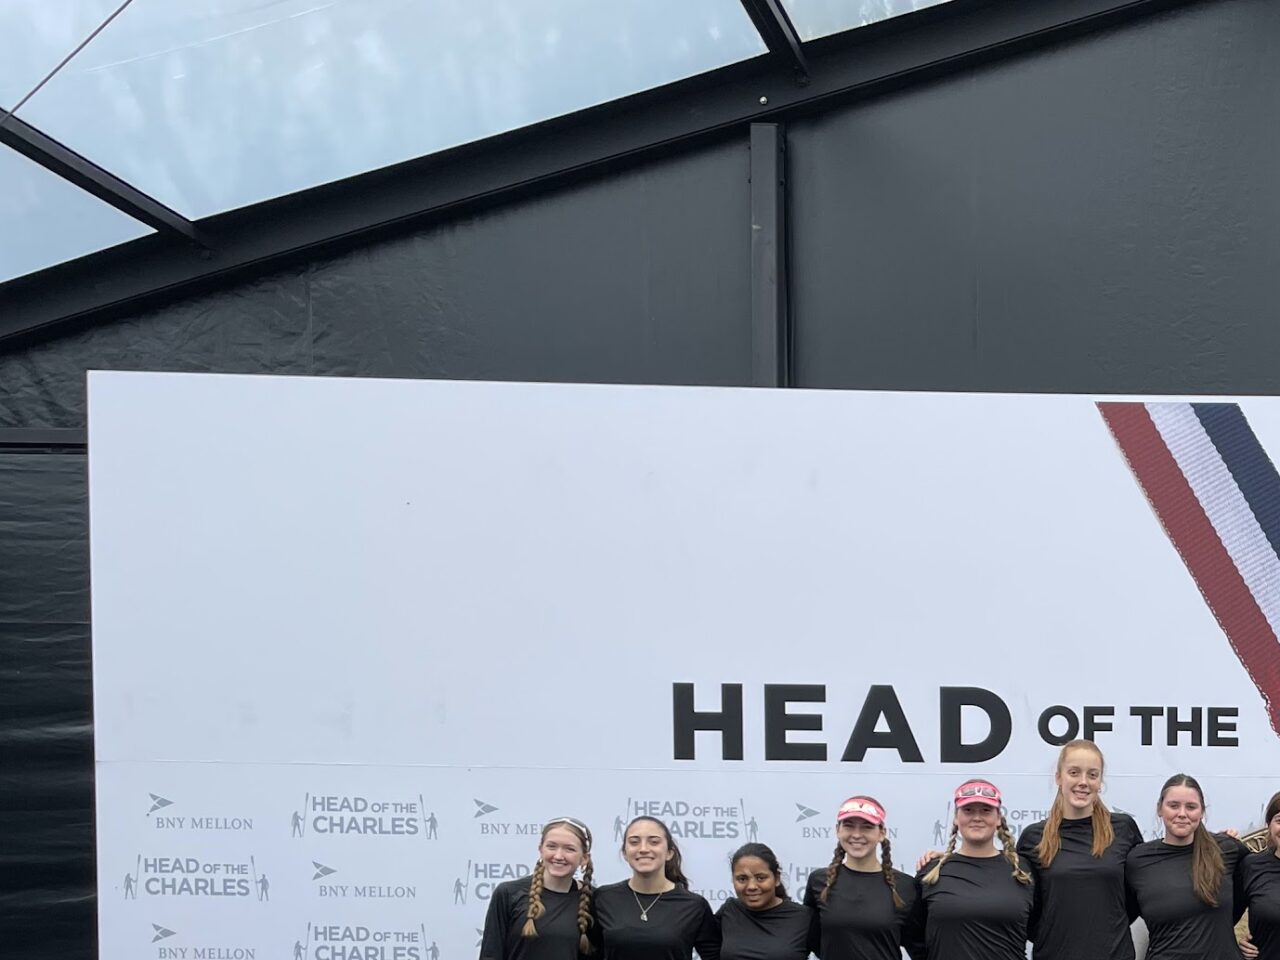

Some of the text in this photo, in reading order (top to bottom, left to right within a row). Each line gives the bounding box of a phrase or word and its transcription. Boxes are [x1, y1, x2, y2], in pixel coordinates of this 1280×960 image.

[673, 683, 1012, 763] HEAD
[1038, 705, 1116, 748] OF
[1130, 706, 1239, 747] THE
[312, 796, 417, 814] HEAD OF THE
[634, 800, 738, 818] HEAD OF THE
[156, 817, 253, 830] BNY MELLON
[1010, 810, 1049, 821] OF TH
[313, 815, 419, 835] CHARLES
[481, 823, 509, 835] BNY
[668, 821, 739, 839] ARLES
[802, 827, 832, 839] BNY
[144, 858, 249, 875] HEAD OF THE
[474, 864, 529, 879] HEAD
[145, 877, 250, 896] CHARLES
[319, 885, 416, 898] BNY MELLON
[314, 926, 419, 943] HEAD OF THE
[158, 947, 256, 960] BNY MELLON
